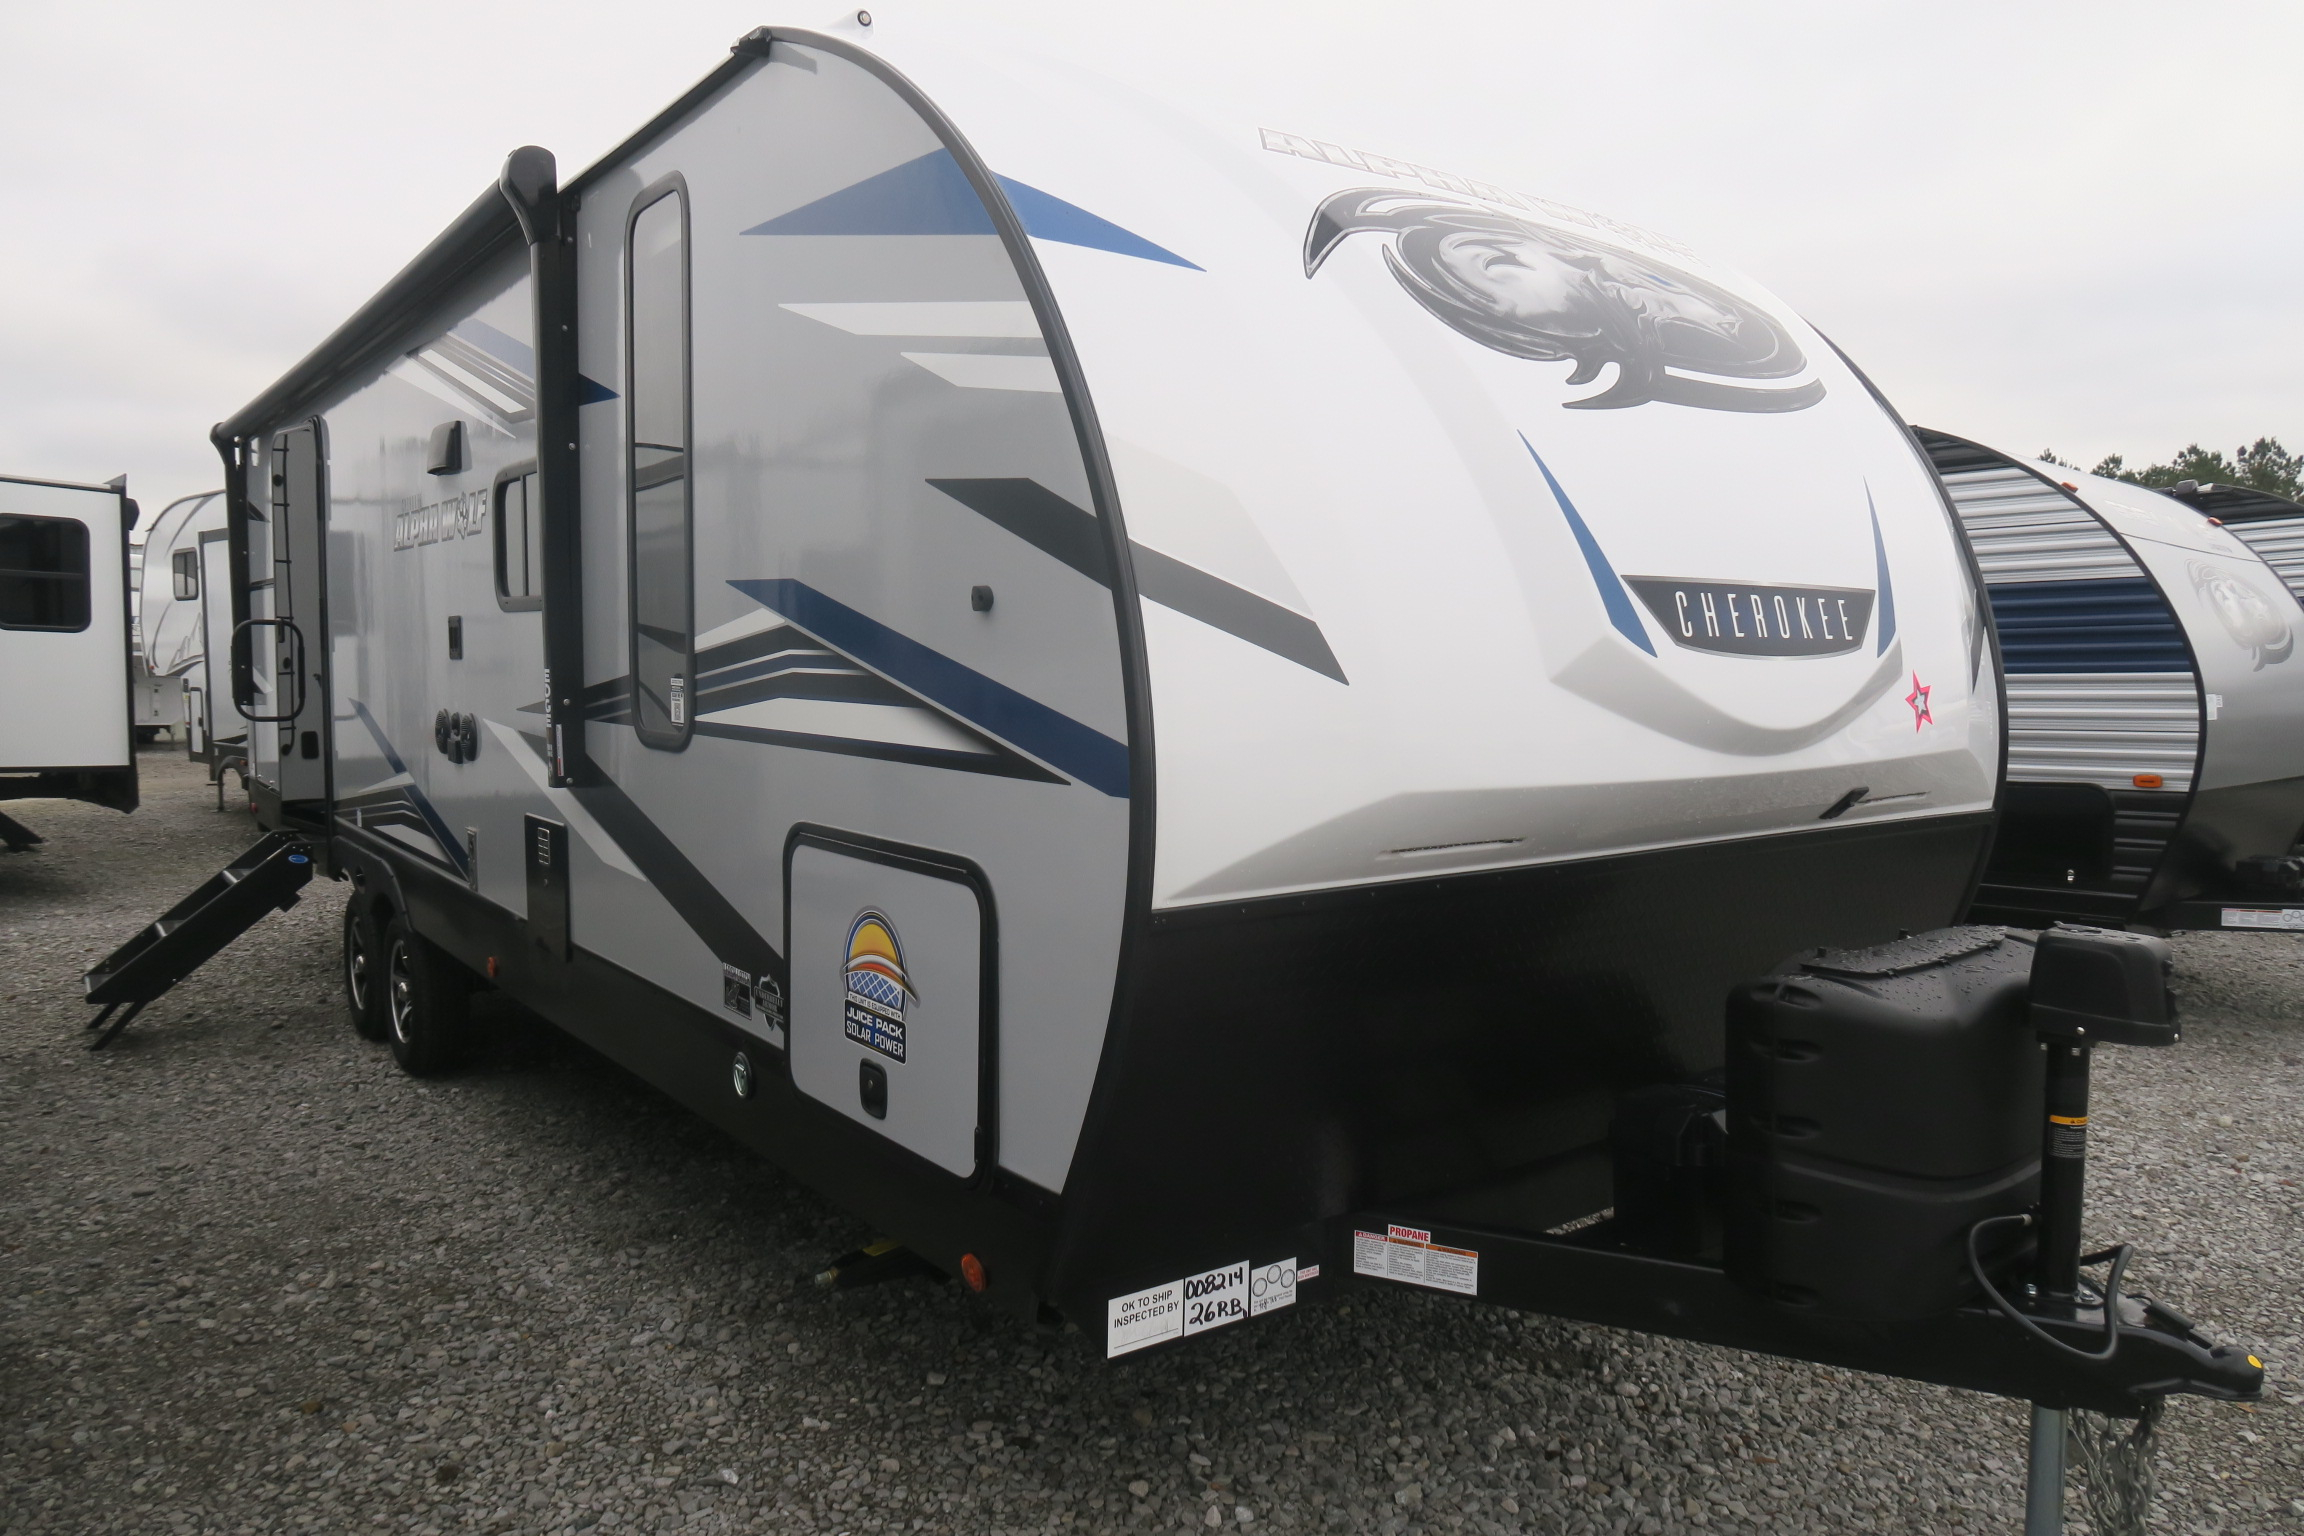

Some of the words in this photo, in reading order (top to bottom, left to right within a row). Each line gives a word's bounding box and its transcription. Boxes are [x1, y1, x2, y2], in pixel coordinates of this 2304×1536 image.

[394, 503, 439, 552] ALPHA
[1675, 590, 1853, 640] CHEROKEE
[846, 1006, 873, 1027] JUICE
[875, 1018, 903, 1040] PACK
[846, 1020, 871, 1043] SOLAR
[874, 1033, 904, 1058] POWER
[1389, 1225, 1429, 1242] PROPANE
[1185, 1266, 1243, 1300] 008214
[1114, 1304, 1165, 1329] INSPECTED
[1167, 1300, 1180, 1313] BY
[1121, 1301, 1135, 1313] OK
[1138, 1296, 1150, 1309] TO
[1152, 1289, 1173, 1304] SHIP
